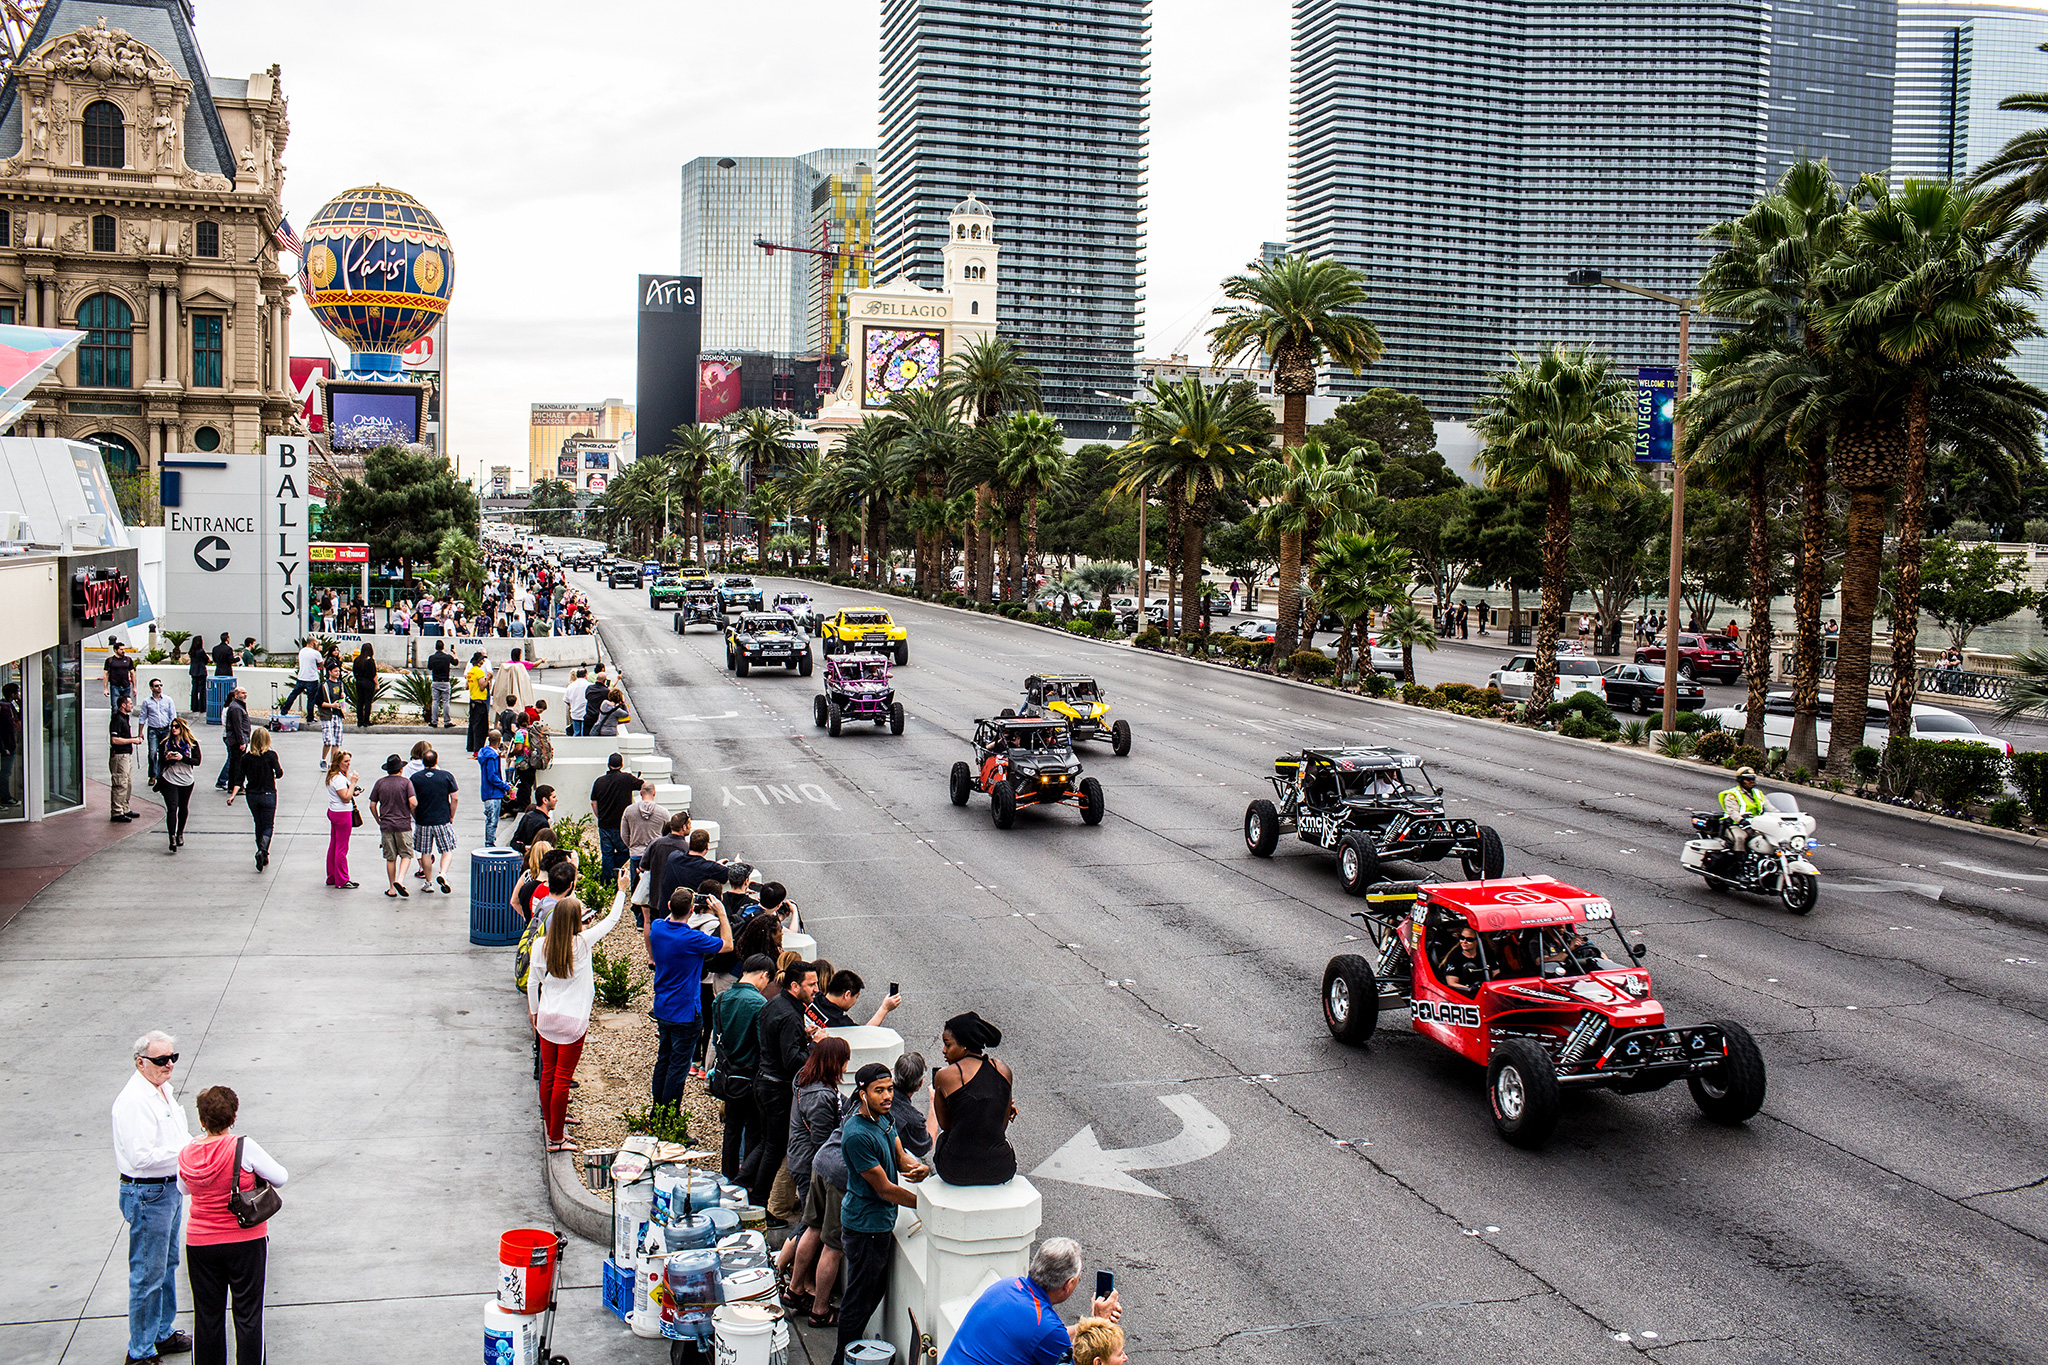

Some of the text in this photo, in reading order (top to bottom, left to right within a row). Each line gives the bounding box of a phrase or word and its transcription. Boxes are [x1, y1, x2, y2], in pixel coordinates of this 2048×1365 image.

[344, 227, 406, 297] Paris
[645, 279, 696, 306] Aria
[861, 300, 947, 317] BELLAGIO
[1639, 380, 1665, 388] WELCOME
[352, 414, 393, 426] OMNIA
[567, 412, 600, 425] ONE
[1636, 390, 1653, 455] LAS VEGAS
[171, 512, 254, 533] ENTRANCE
[276, 444, 300, 616] BALLYS
[1299, 816, 1323, 828] kmc
[1411, 1000, 1480, 1028] POLARIS
